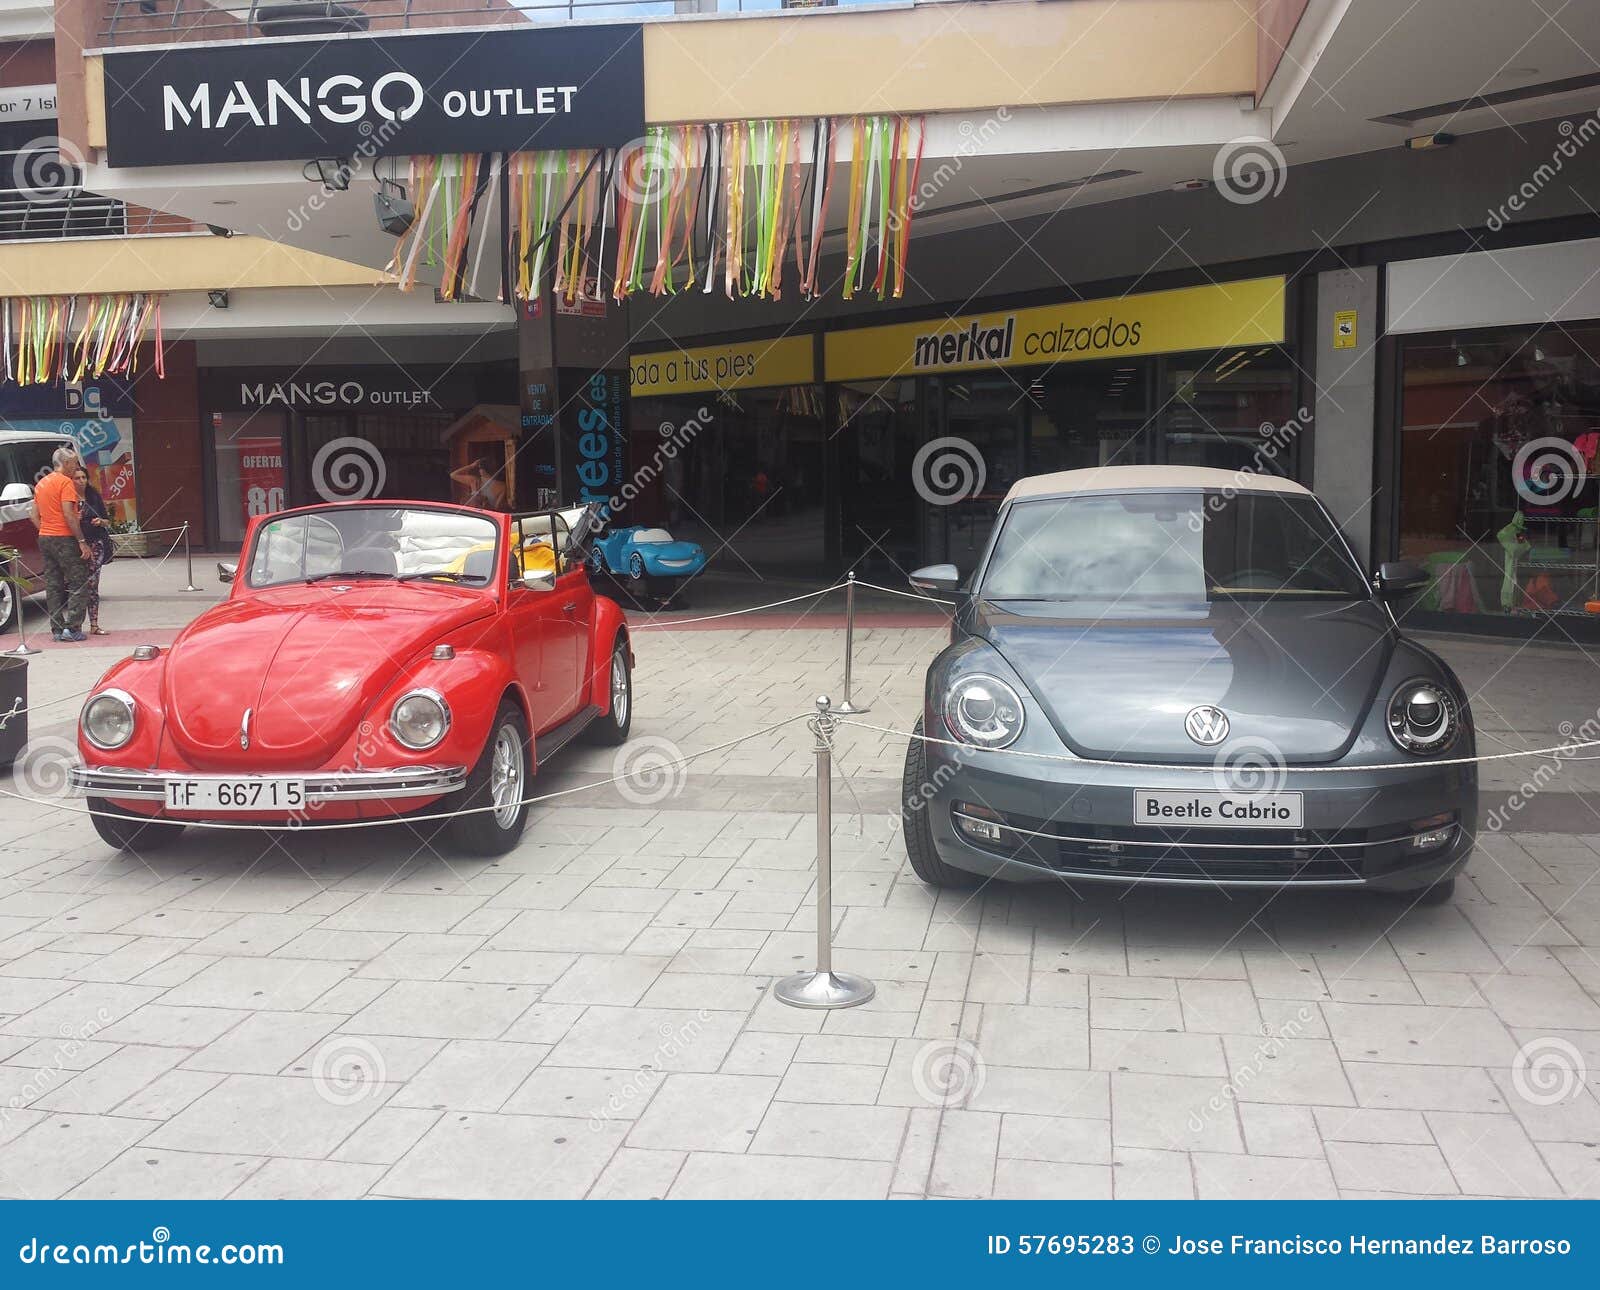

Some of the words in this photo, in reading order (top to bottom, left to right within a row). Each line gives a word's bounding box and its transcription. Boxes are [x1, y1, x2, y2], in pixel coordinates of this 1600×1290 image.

[22, 98, 32, 111] 7
[162, 71, 424, 131] MANGO
[442, 86, 578, 118] OUTLET
[913, 317, 1015, 367] merkal
[1024, 317, 1142, 356] calzados
[666, 361, 678, 382] a
[684, 354, 709, 381] tus
[716, 349, 755, 384] pies
[241, 382, 364, 405] MANGO
[370, 391, 431, 404] OUTLET
[527, 384, 546, 395] VENTA
[577, 373, 609, 512] rées.es
[243, 455, 283, 469] OFERTA
[218, 782, 301, 806] 66715
[1146, 799, 1213, 818] Beetle
[1218, 800, 1291, 820] Cabrio
